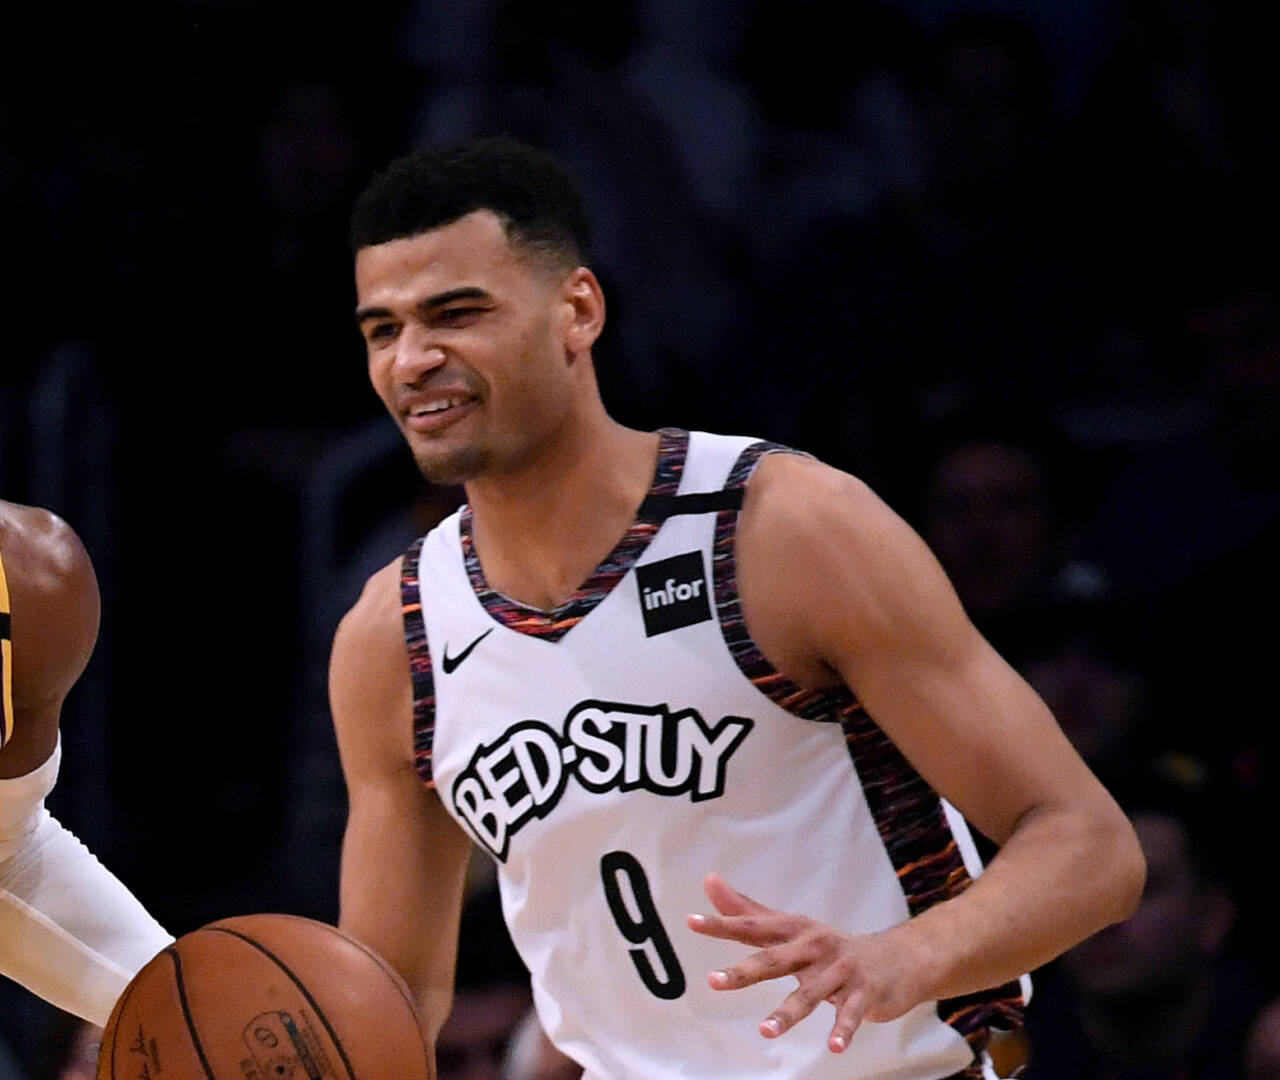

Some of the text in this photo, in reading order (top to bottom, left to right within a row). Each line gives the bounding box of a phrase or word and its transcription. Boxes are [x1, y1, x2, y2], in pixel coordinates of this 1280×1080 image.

[643, 578, 704, 611] infor
[452, 699, 755, 864] BED-STUY
[600, 851, 686, 1000] 9
